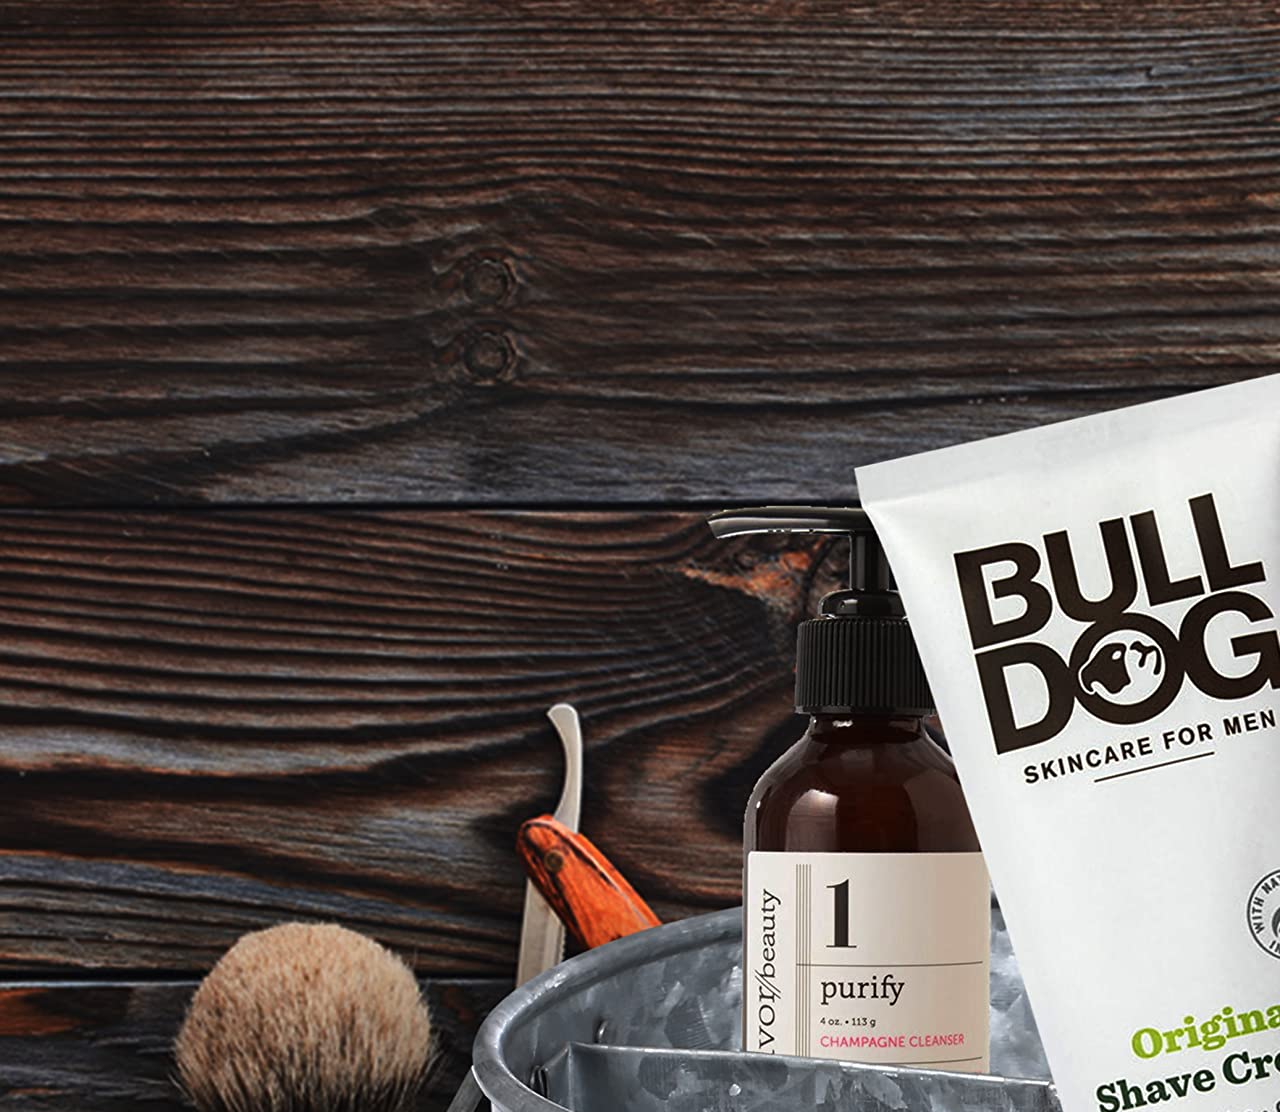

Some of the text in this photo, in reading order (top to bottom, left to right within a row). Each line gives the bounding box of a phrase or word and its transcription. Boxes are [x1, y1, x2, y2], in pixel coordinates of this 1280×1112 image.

[954, 493, 1266, 650] BULL
[1024, 709, 1277, 784] SKINCARE FOR MEN
[826, 878, 857, 948] 1
[1252, 897, 1265, 934] WITH
[820, 974, 905, 1005] purify
[820, 1017, 826, 1025] 4
[852, 1017, 867, 1026] 113
[869, 1018, 876, 1028] g
[820, 1034, 964, 1048] CHAMPAGNE CLEANSER
